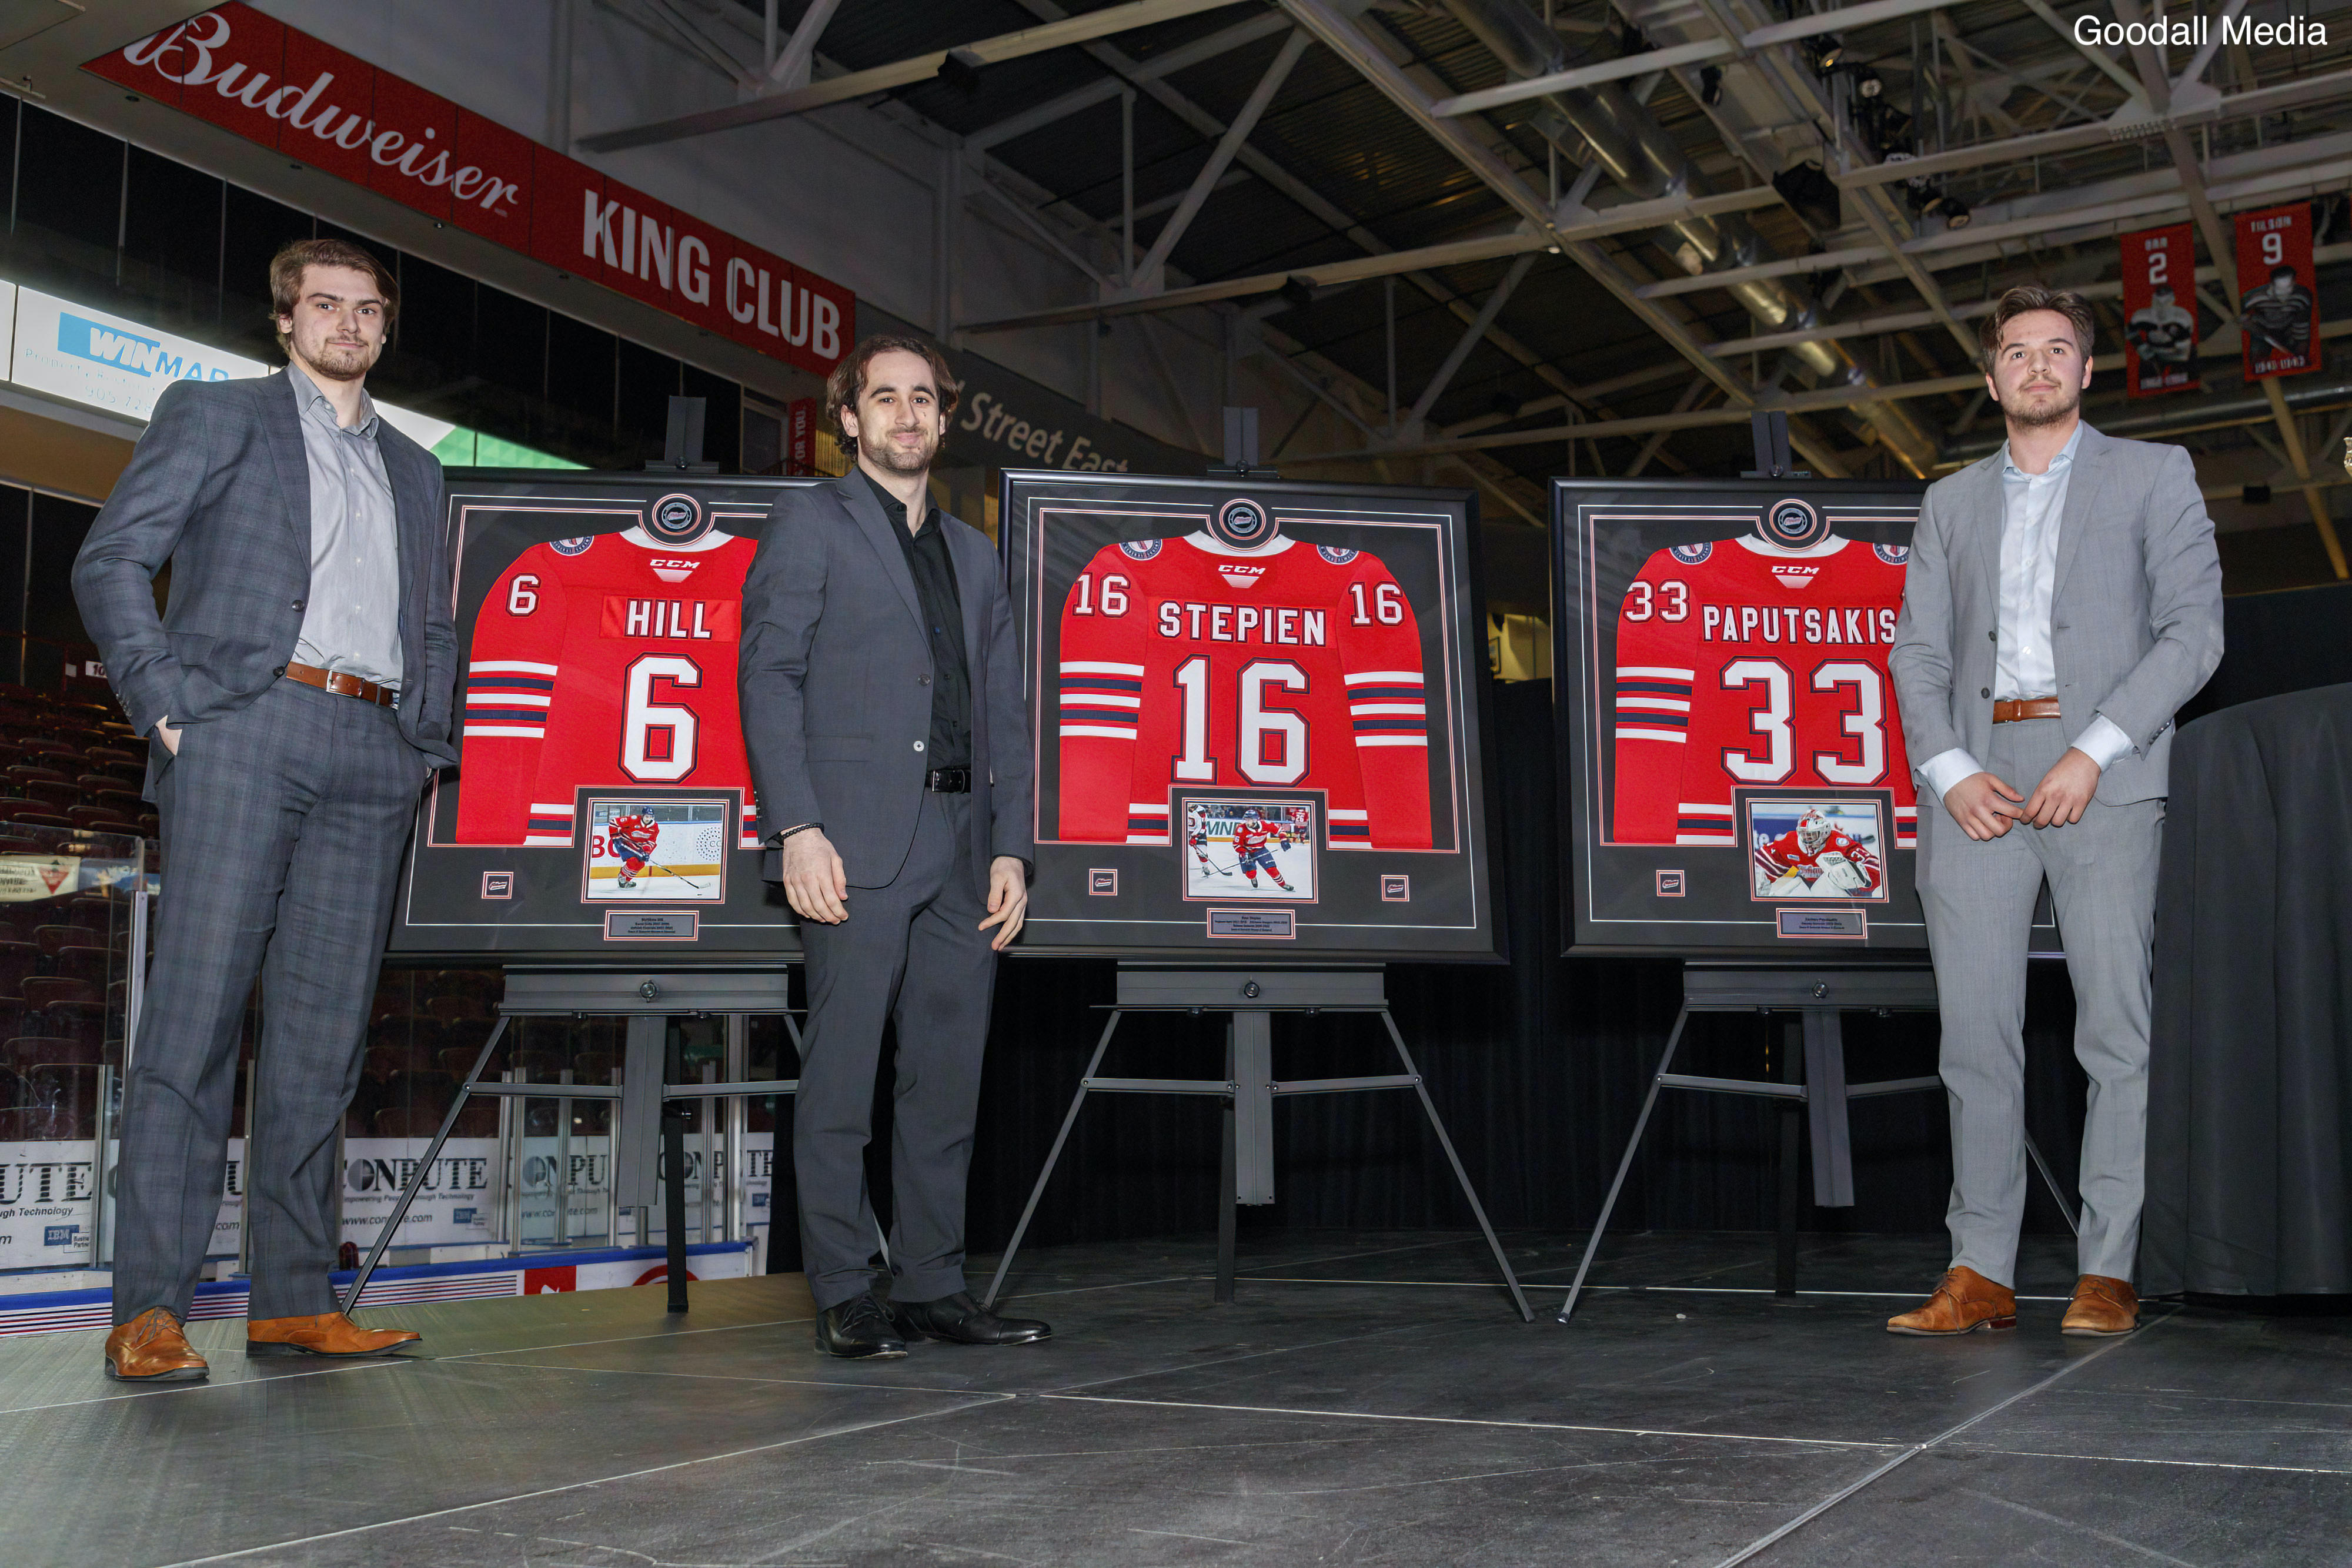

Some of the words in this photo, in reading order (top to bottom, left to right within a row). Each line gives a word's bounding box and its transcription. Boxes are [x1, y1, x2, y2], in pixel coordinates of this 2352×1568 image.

[123, 12, 518, 209] Budweiser
[2149, 253, 2169, 285] 2
[2261, 233, 2283, 265] 9
[583, 189, 710, 307] KING
[726, 257, 840, 360] CLUB
[961, 392, 1063, 464] Street
[650, 559, 700, 569] CCM
[1218, 565, 1266, 575] CCM
[1771, 566, 1820, 574] CCM
[506, 573, 542, 616] 6
[1073, 573, 1130, 617] 16
[1349, 581, 1404, 627] 16
[1625, 579, 1690, 623] 33
[624, 599, 712, 640] HILL
[1157, 600, 1326, 646] STEPIEN
[1703, 604, 1896, 644] PAPUTSAKIS
[618, 653, 703, 783] 6
[1171, 654, 1310, 787] 16
[1719, 656, 1889, 786] 33
[19, 1207, 74, 1216] Technology
[48, 1229, 70, 1241] IBM
